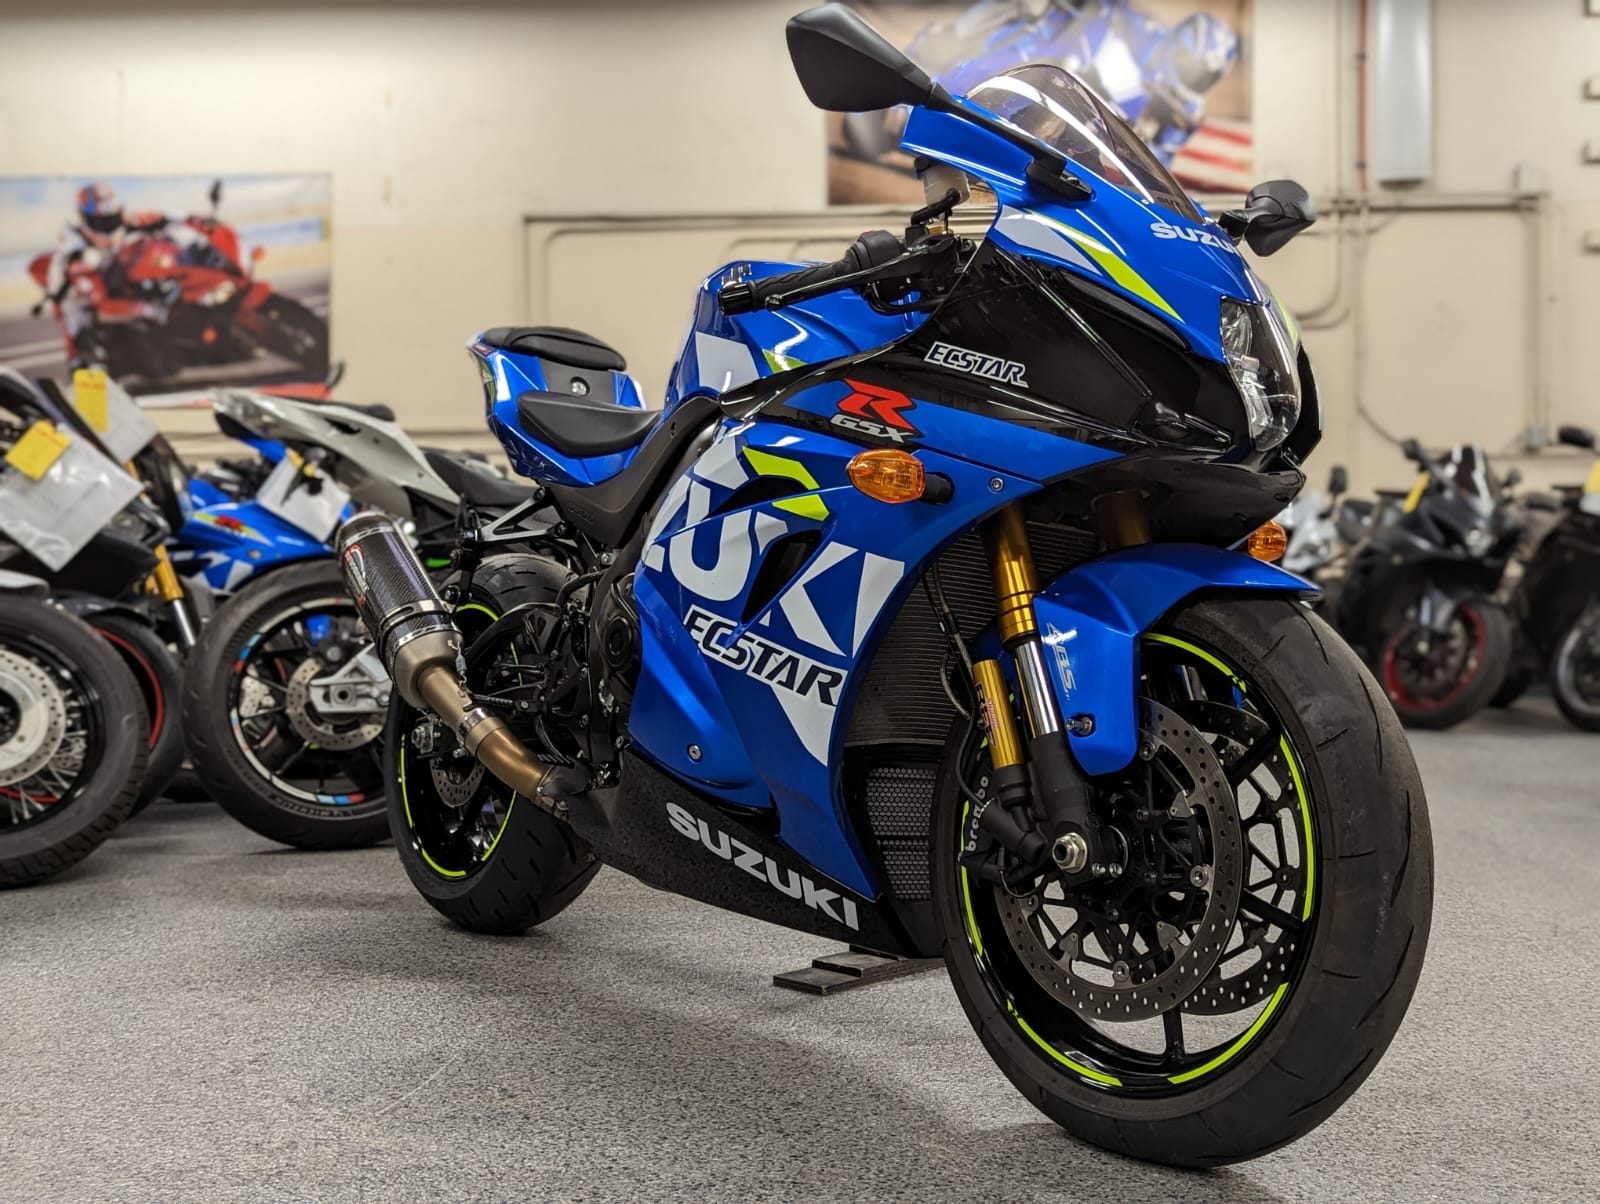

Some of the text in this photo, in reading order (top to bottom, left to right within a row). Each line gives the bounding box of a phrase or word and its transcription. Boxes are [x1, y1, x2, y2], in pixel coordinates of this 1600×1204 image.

[1150, 222, 1238, 254] SUZU
[924, 341, 1028, 389] ECSTAR
[830, 413, 915, 443] GSX
[837, 378, 915, 431] R
[684, 604, 848, 707] ECSTAR
[665, 801, 860, 932] SUZUKI
